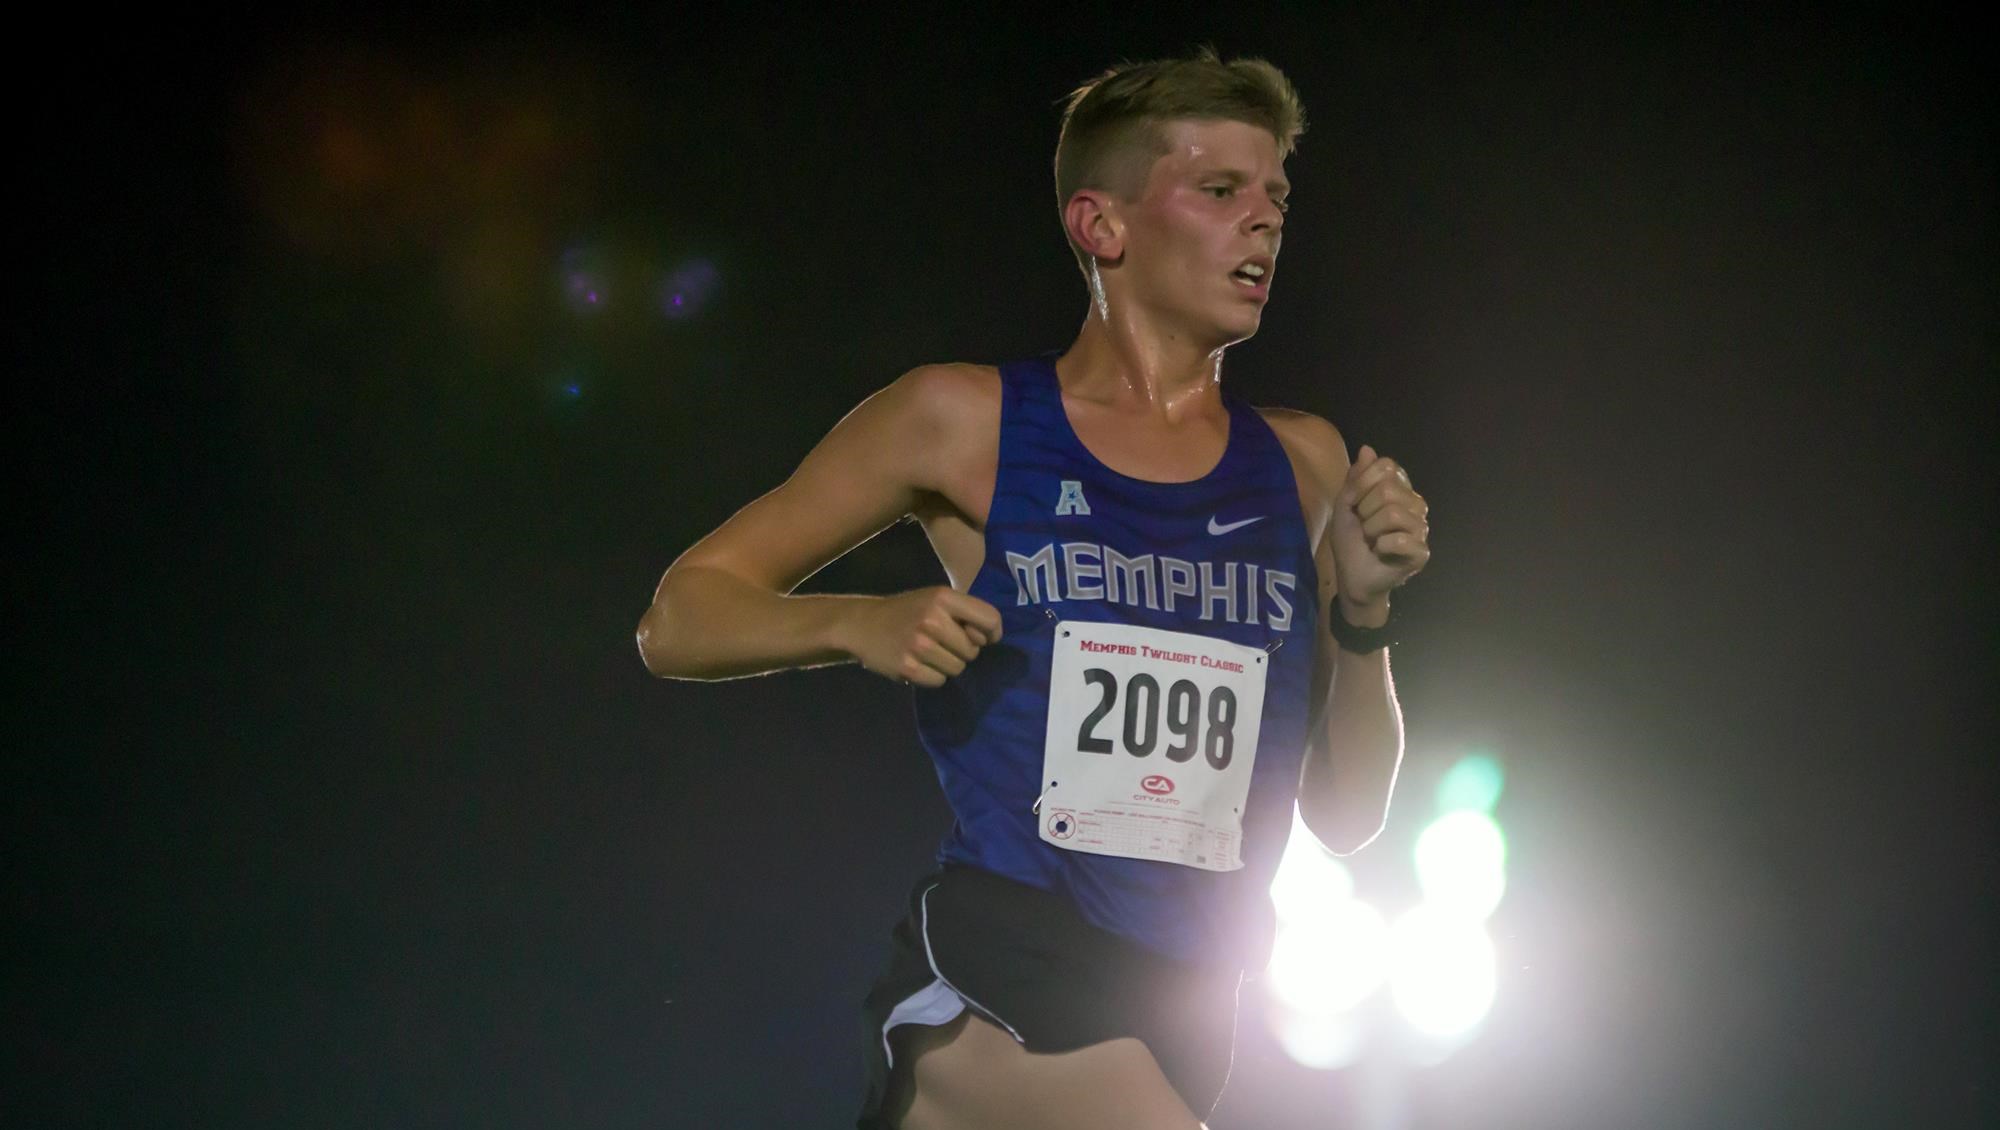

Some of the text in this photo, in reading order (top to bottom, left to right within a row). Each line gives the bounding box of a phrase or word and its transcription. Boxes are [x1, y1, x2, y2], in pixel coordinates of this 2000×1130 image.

[1006, 542, 1296, 631] MEMPHIS
[1080, 640, 1245, 674] MEMPHIS TWILIGHT CLASSIC
[1077, 668, 1237, 771] 2098
